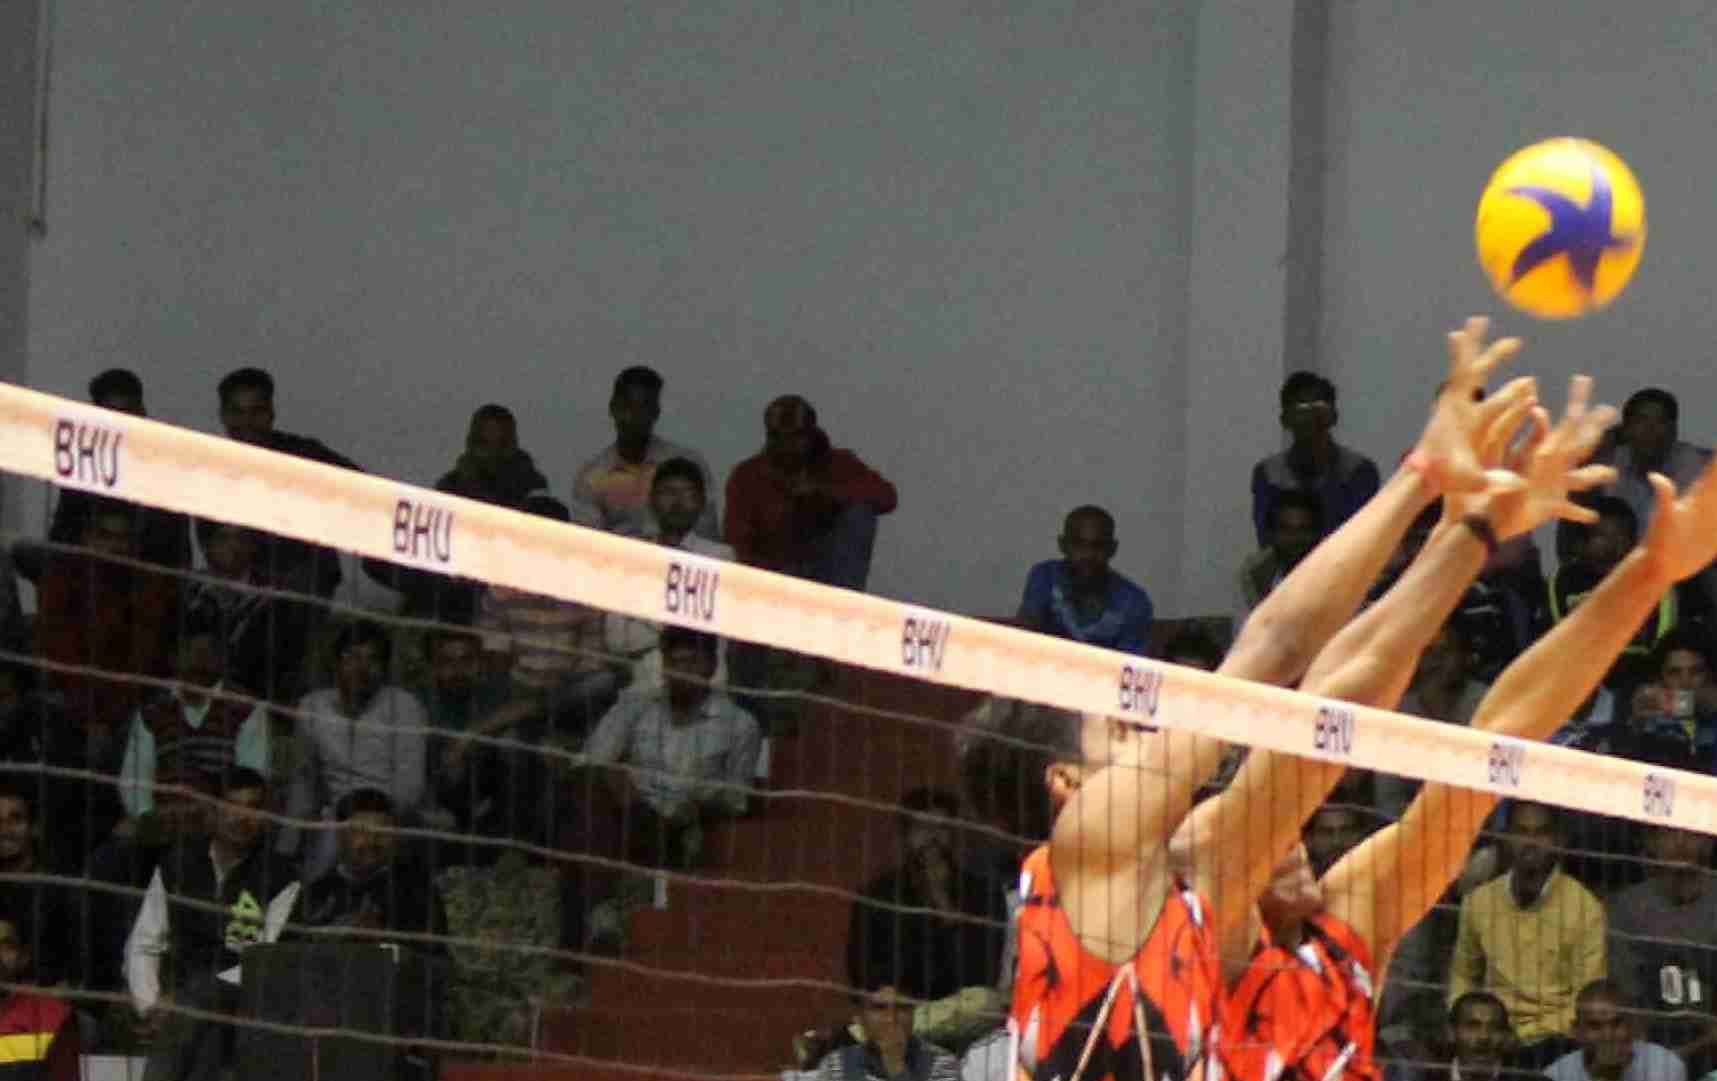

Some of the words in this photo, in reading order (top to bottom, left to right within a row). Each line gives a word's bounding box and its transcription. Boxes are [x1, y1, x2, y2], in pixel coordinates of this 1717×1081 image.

[54, 420, 123, 487] BHU
[391, 499, 455, 562] BHU
[664, 562, 721, 621] BHU
[901, 617, 951, 673] BHU
[1118, 664, 1163, 717] BHU
[1314, 705, 1354, 754] BHU
